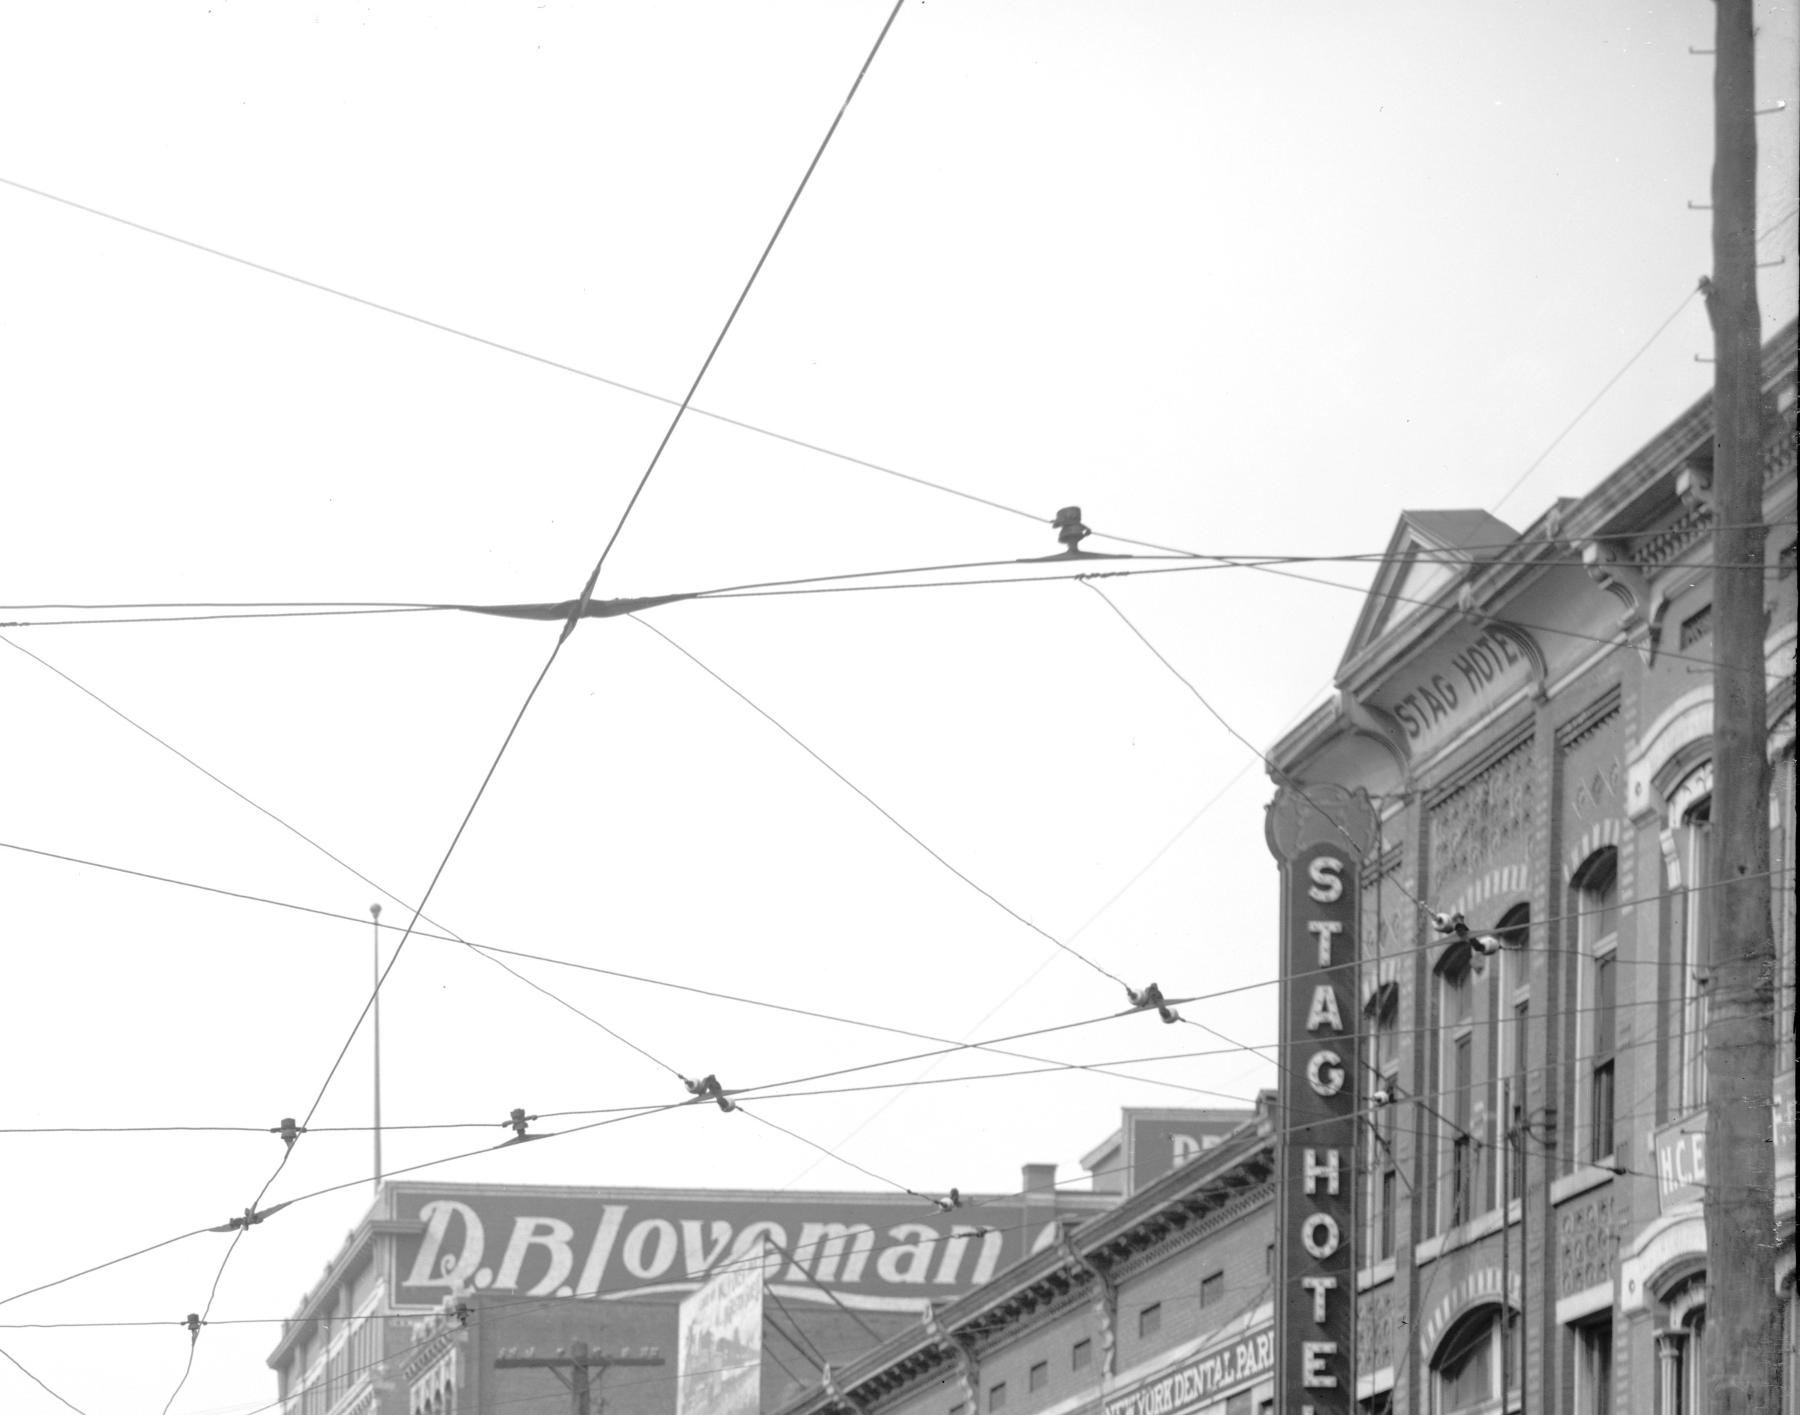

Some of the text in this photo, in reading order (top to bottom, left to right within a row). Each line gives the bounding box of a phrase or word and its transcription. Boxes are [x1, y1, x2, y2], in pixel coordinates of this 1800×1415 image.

[1394, 626, 1521, 740] STAG HOTE
[1306, 856, 1345, 1097] STAG
[1173, 1351, 1234, 1408] DENTAL
